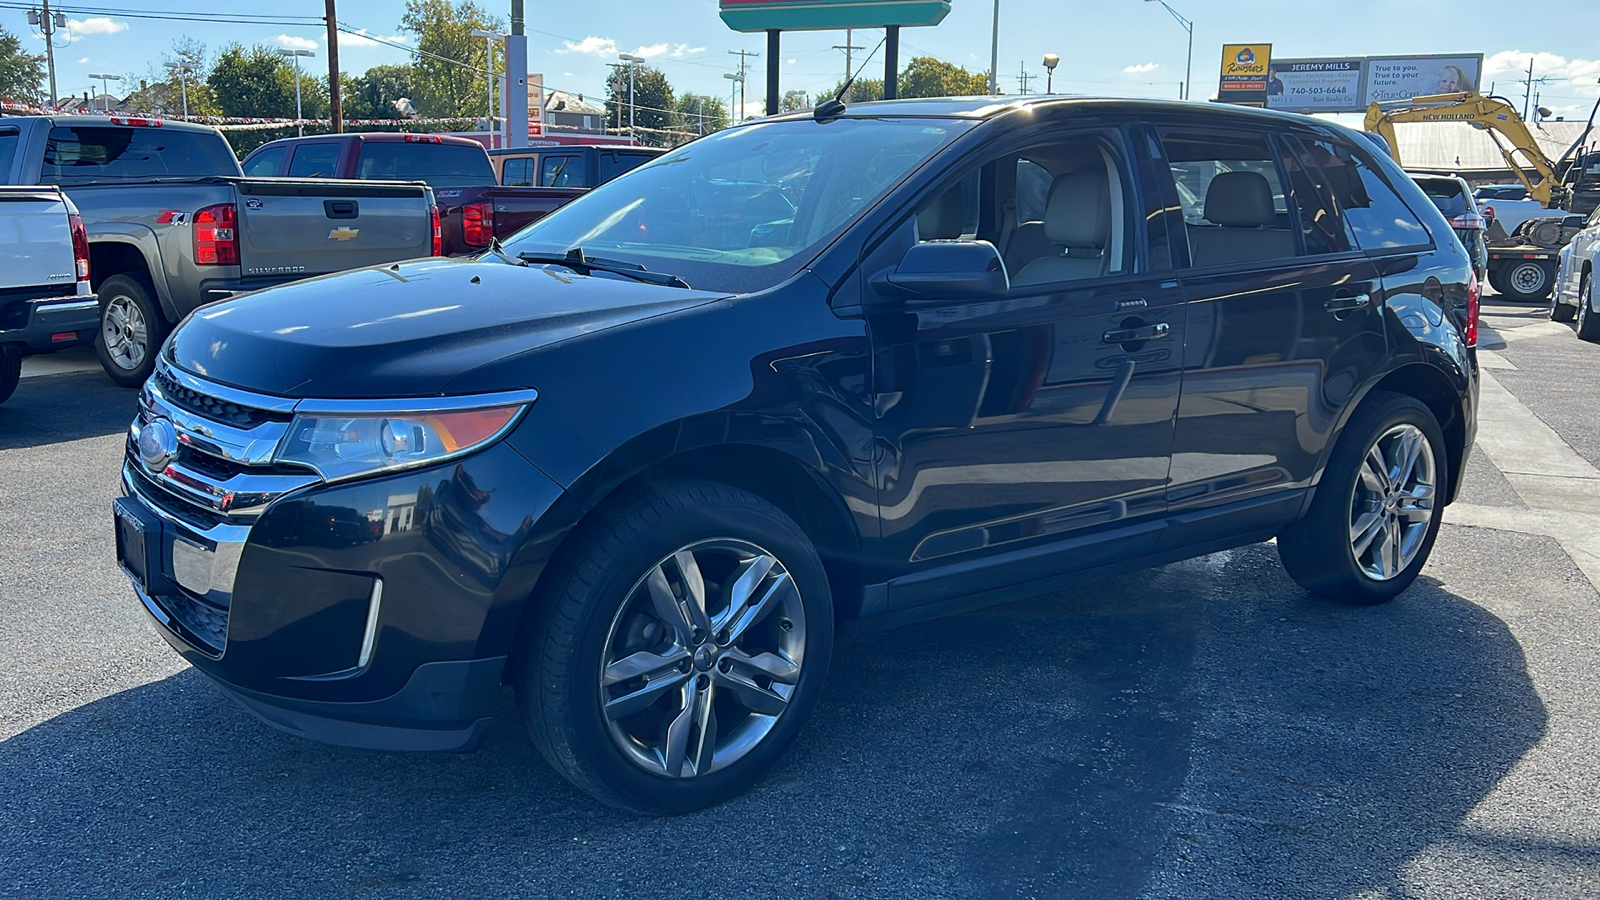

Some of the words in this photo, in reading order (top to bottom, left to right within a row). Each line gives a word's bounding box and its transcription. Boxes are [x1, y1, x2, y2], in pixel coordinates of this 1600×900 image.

[1226, 62, 1264, 74] Roosters
[1325, 62, 1350, 70] MILLS
[1403, 65, 1418, 73] you.
[1402, 72, 1419, 80] your
[1291, 87, 1347, 95] 740-503-6648
[1326, 96, 1343, 104] Realty
[156, 209, 192, 227] Z71
[249, 266, 305, 274] SILVERADO
